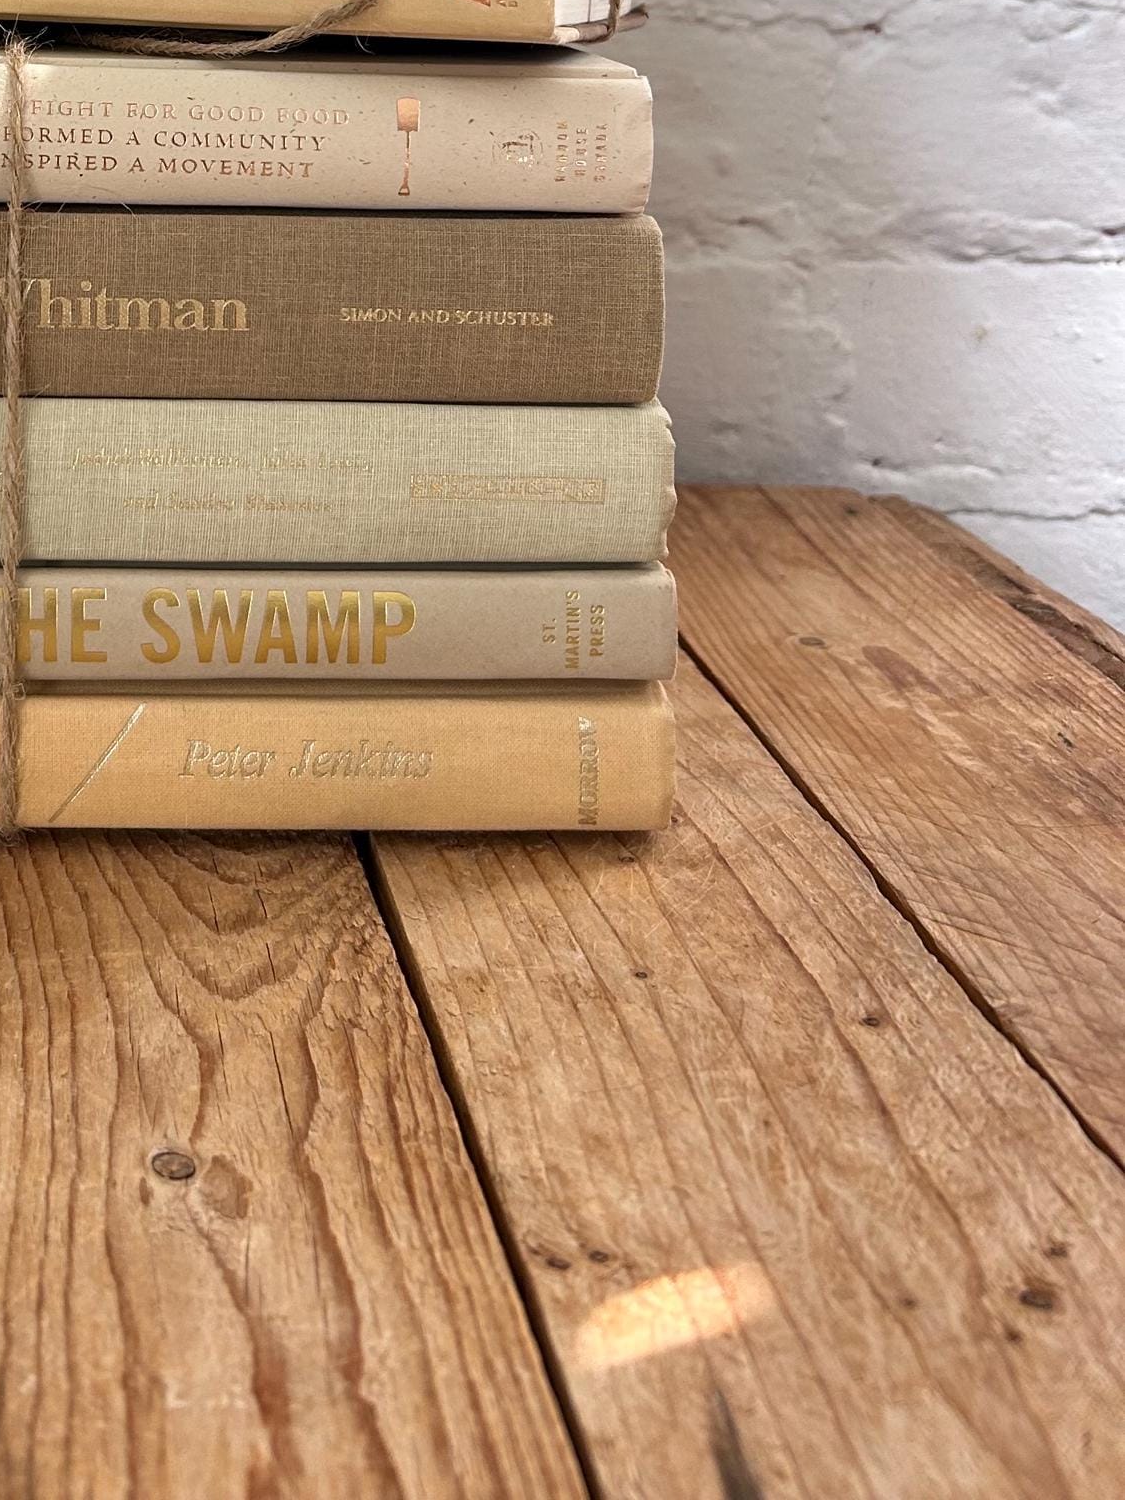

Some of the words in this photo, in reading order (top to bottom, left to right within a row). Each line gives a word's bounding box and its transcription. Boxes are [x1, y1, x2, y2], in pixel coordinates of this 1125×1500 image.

[31, 99, 113, 119] FIGHT
[126, 102, 178, 121] FOR
[188, 104, 266, 124] GOOD
[276, 106, 351, 127] FOOD
[126, 130, 142, 146] A
[154, 130, 327, 151] COMMUNITY
[575, 127, 588, 177] HOUSE
[129, 156, 146, 174] A
[158, 158, 314, 179] MOVEMENT
[339, 307, 403, 324] SIMON
[408, 308, 450, 325] AND
[455, 309, 555, 327] SCHUSTER
[140, 586, 417, 666] SWAMP
[543, 617, 556, 644] ST.
[565, 590, 580, 669] MARTIN'S
[590, 604, 605, 658] PRESS
[177, 738, 277, 781] Peter
[287, 737, 435, 781] Jenkins
[578, 715, 600, 826] MORROW
